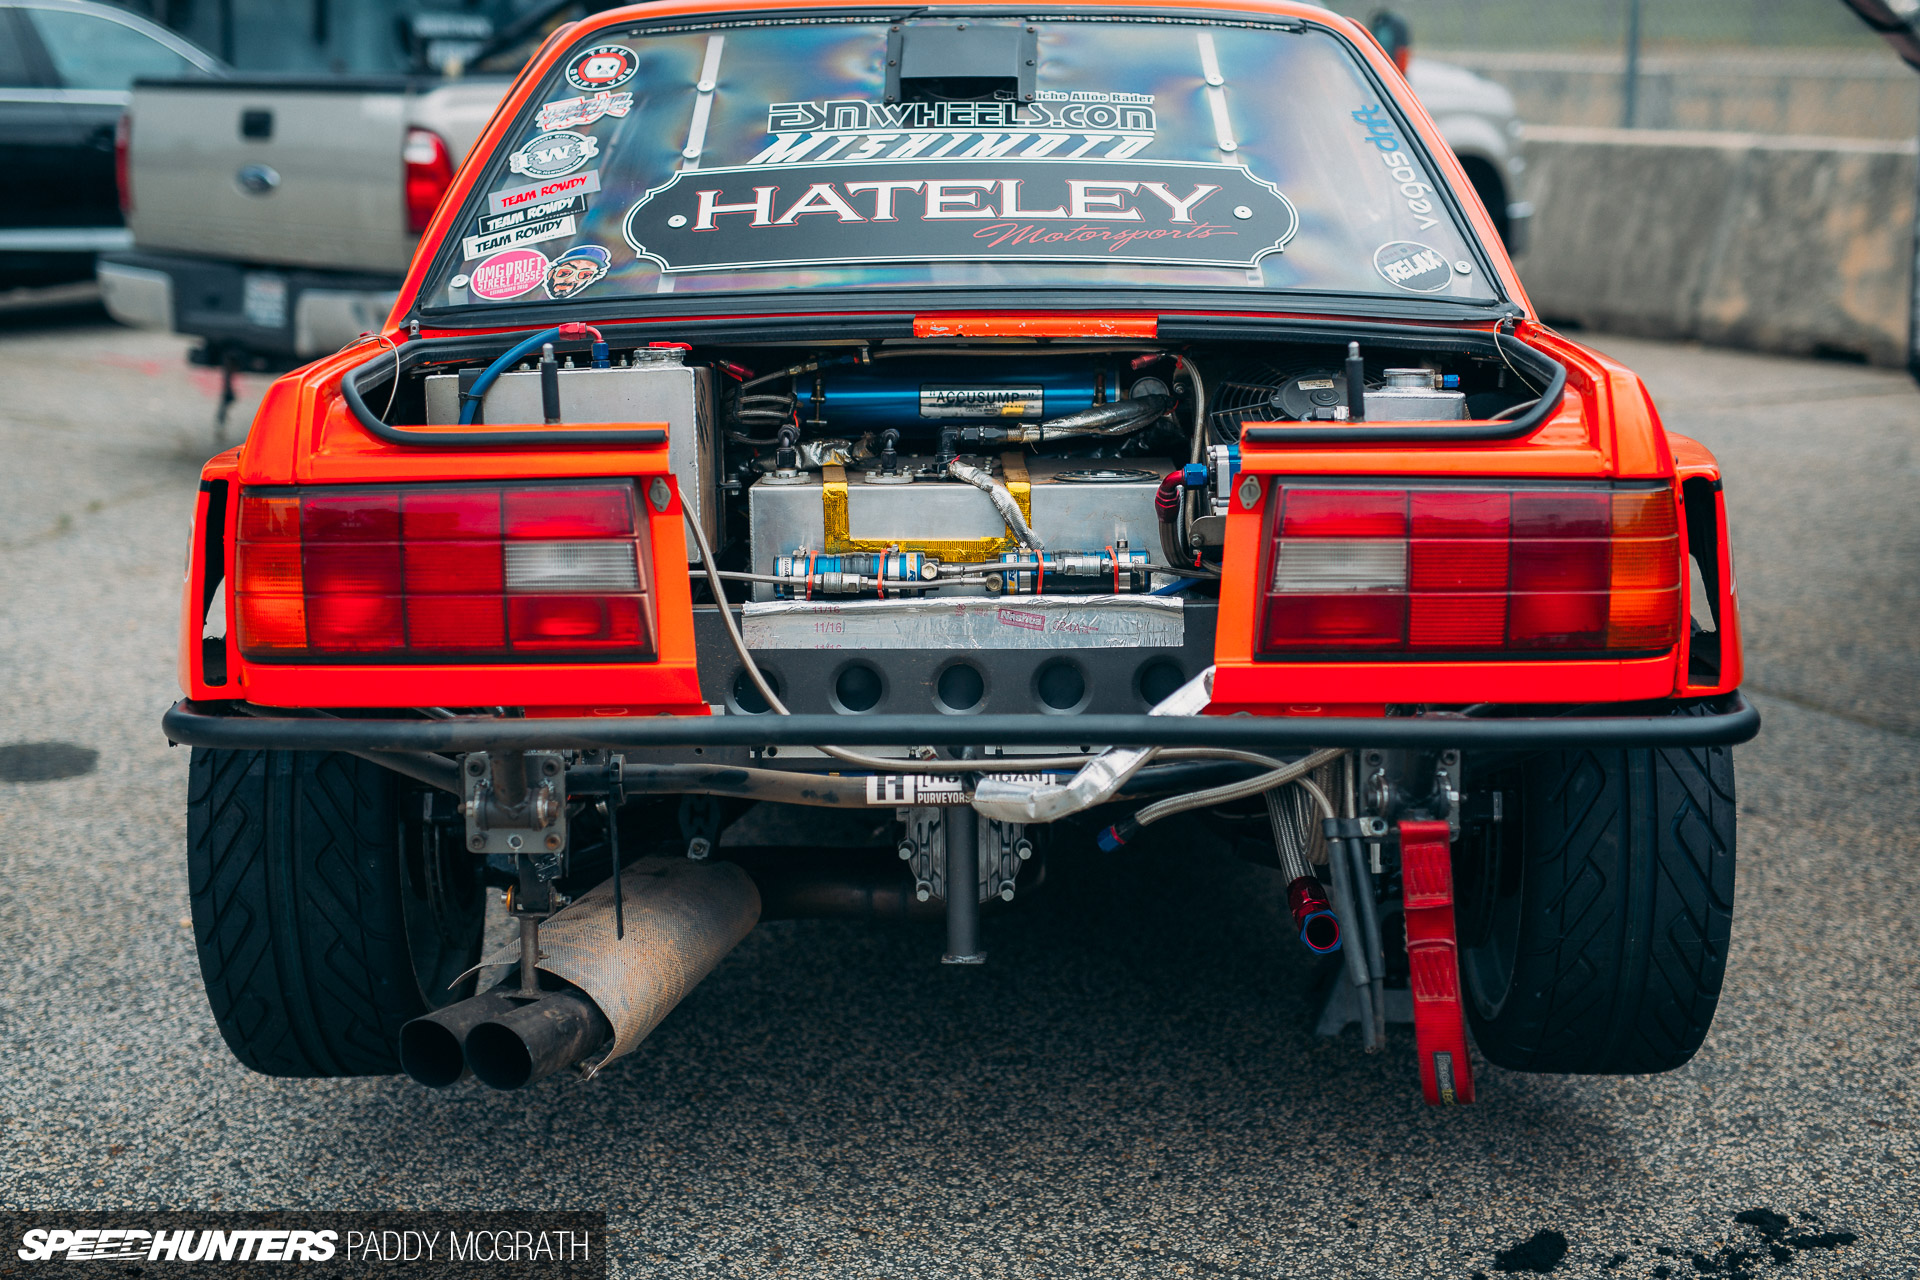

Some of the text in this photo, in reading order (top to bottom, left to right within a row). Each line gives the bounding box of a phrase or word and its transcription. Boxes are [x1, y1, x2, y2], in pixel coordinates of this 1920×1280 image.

[588, 48, 627, 56] TOFU
[569, 68, 633, 88] DRIFT VAN
[1110, 92, 1155, 104] Rader
[746, 132, 1155, 165] MISHIMOTO
[501, 176, 587, 207] TEAM ROWDY
[691, 179, 1222, 232] HATELEY
[487, 212, 524, 231] TEAM
[527, 196, 576, 220] ROWDY
[475, 218, 562, 253] TEAM ROWDY
[973, 222, 1238, 252] Motorsports
[478, 275, 511, 291] STREET
[514, 270, 541, 285] POSSE
[1384, 250, 1442, 283] RELAX
[812, 606, 840, 614] 11/16
[814, 622, 842, 633] 11/16
